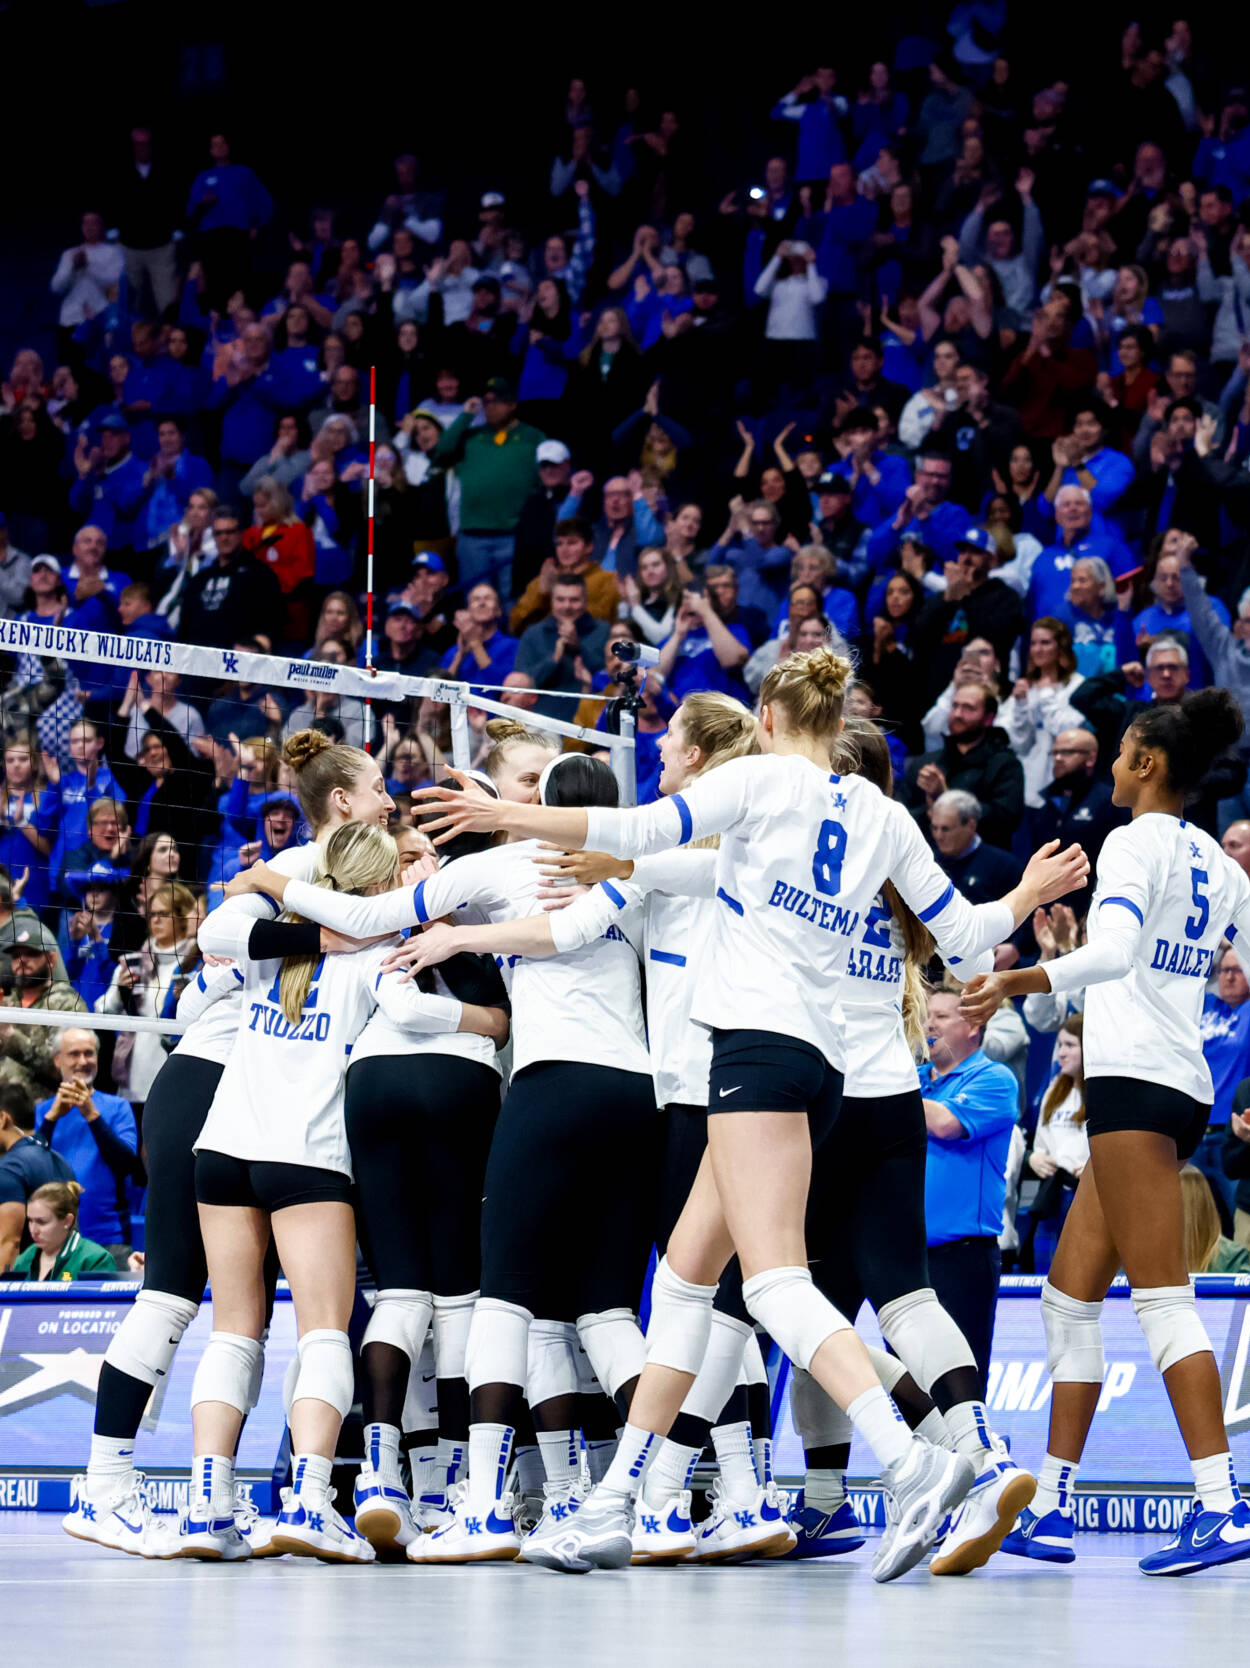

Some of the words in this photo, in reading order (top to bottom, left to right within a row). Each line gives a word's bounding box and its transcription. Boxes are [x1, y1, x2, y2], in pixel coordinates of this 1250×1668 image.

[97, 634, 173, 665] WILDCATS
[222, 651, 239, 673] UK
[287, 662, 311, 680] paul
[310, 665, 339, 680] miller
[812, 818, 848, 897] 8
[1184, 866, 1210, 940] 5
[38, 1321, 59, 1334] ON
[63, 1321, 122, 1335] LOCATIO
[81, 1501, 97, 1523] UK
[307, 1510, 325, 1533] UK
[550, 1502, 569, 1522] UK
[733, 1509, 758, 1530] UK
[1069, 1496, 1099, 1527] BIG
[1106, 1497, 1135, 1529] ON
[464, 1516, 483, 1536] UK
[641, 1515, 661, 1534] UK
